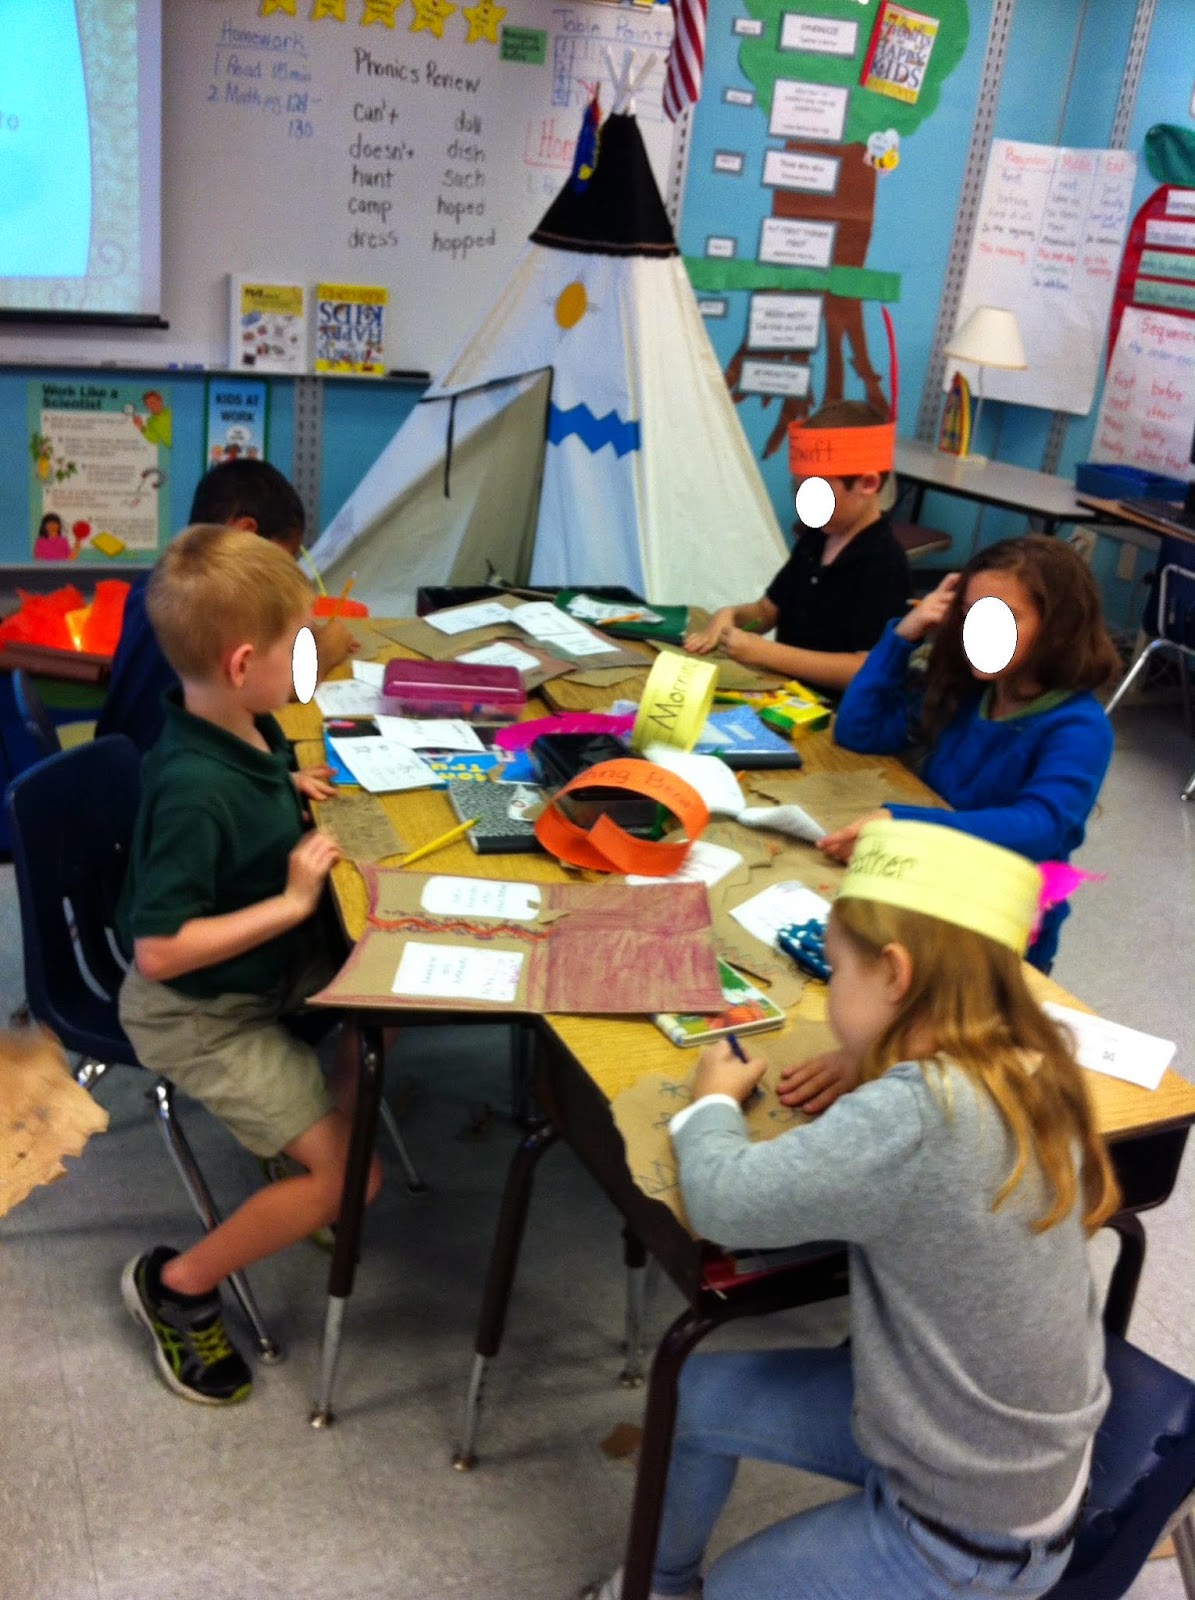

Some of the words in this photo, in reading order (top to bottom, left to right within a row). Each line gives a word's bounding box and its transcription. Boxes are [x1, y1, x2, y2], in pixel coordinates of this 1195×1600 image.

[221, 19, 307, 51] Homework
[353, 47, 420, 84] Phonics
[352, 164, 394, 189] hunt
[347, 197, 393, 224] camp
[437, 195, 485, 225] hoped
[350, 227, 399, 250] dress
[432, 228, 496, 260] hopped
[42, 383, 76, 396] Work
[80, 385, 107, 398] Like
